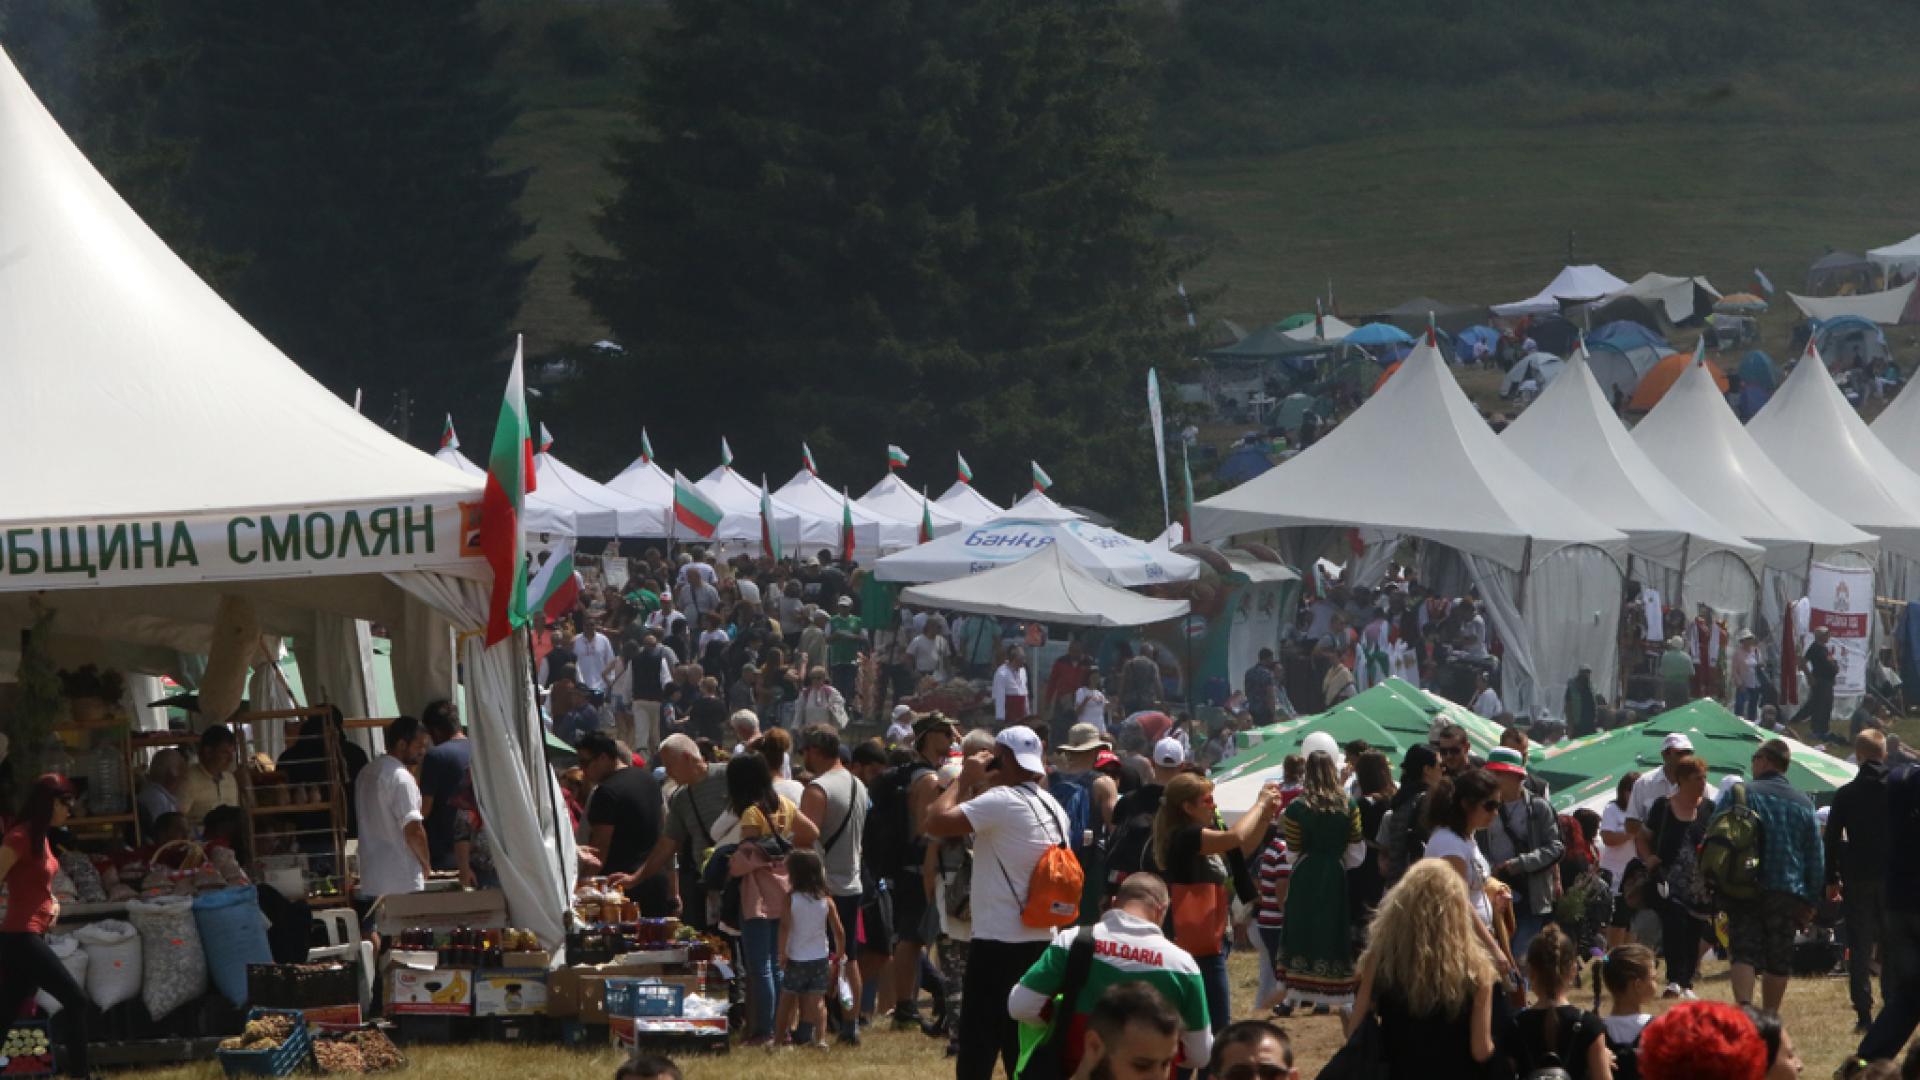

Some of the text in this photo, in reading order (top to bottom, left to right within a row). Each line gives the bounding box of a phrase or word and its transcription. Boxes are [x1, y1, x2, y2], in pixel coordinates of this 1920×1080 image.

[0, 504, 434, 578] БЩИНА СМОЛЯН
[1094, 939, 1163, 966] BULGARIA
